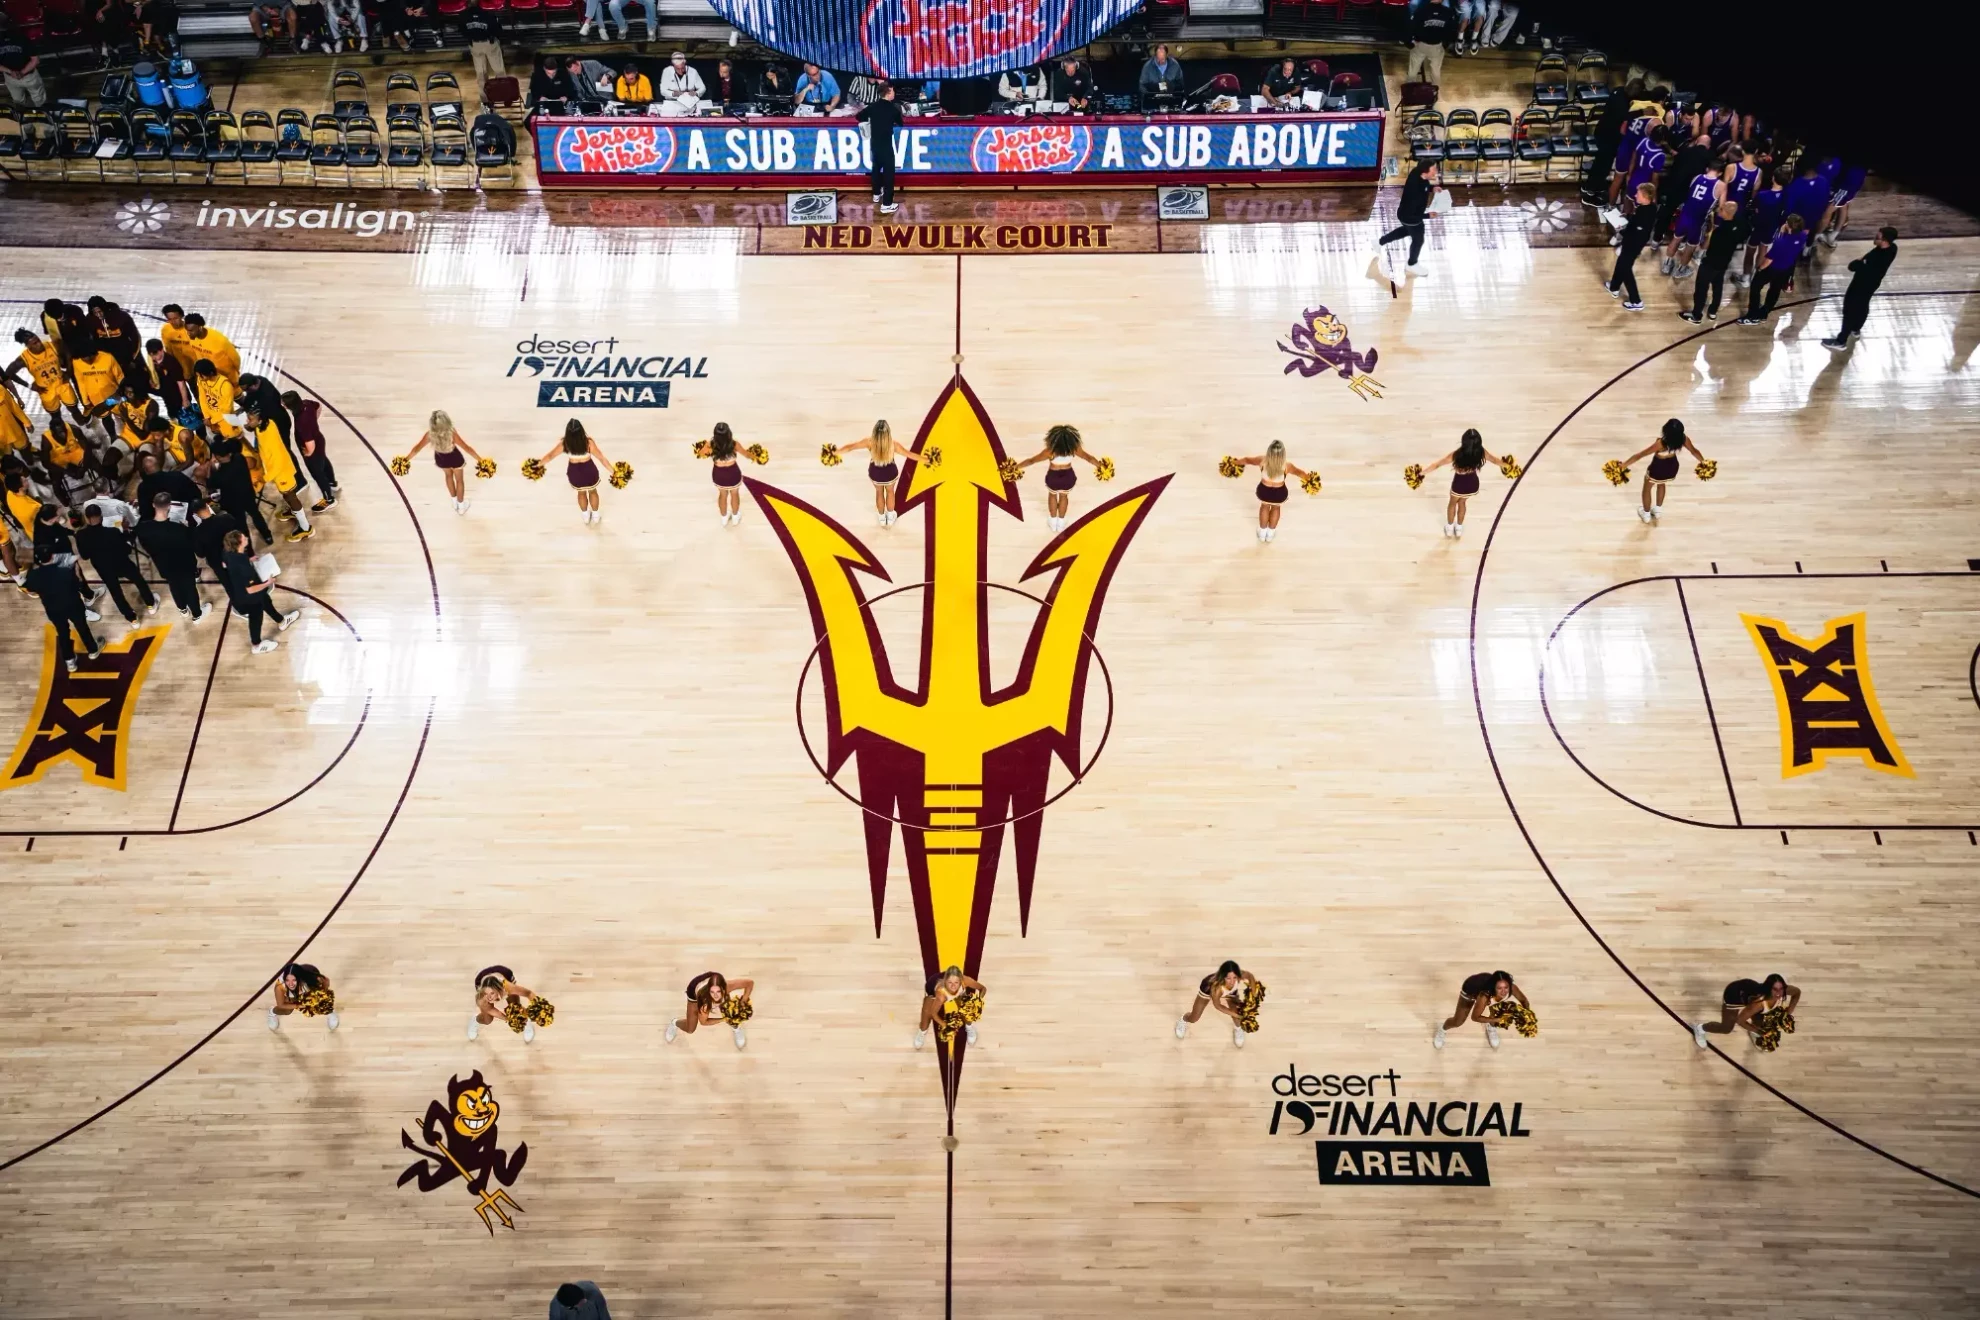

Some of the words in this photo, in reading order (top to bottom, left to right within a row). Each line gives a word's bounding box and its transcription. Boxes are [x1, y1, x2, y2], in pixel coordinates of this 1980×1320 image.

[571, 126, 657, 152] Jersey
[988, 126, 1072, 152] Jersey
[1628, 118, 1644, 135] 32
[688, 129, 711, 170] A
[726, 128, 796, 170] SUB
[1101, 127, 1124, 168] A
[1140, 125, 1212, 168] SUB
[1692, 184, 1708, 200] 12
[1737, 178, 1748, 191] 2
[196, 200, 414, 237] invisalign
[802, 223, 873, 250] NED
[881, 223, 990, 250] WULK
[995, 223, 1114, 250] COURT
[516, 333, 619, 354] desert
[41, 367, 57, 379] 44
[524, 356, 709, 378] FINANCIAL
[550, 386, 656, 403] ARENA
[1272, 1064, 1401, 1097] desert
[1286, 1101, 1530, 1137] FINANCIAL
[1334, 1151, 1472, 1177] ARENA
